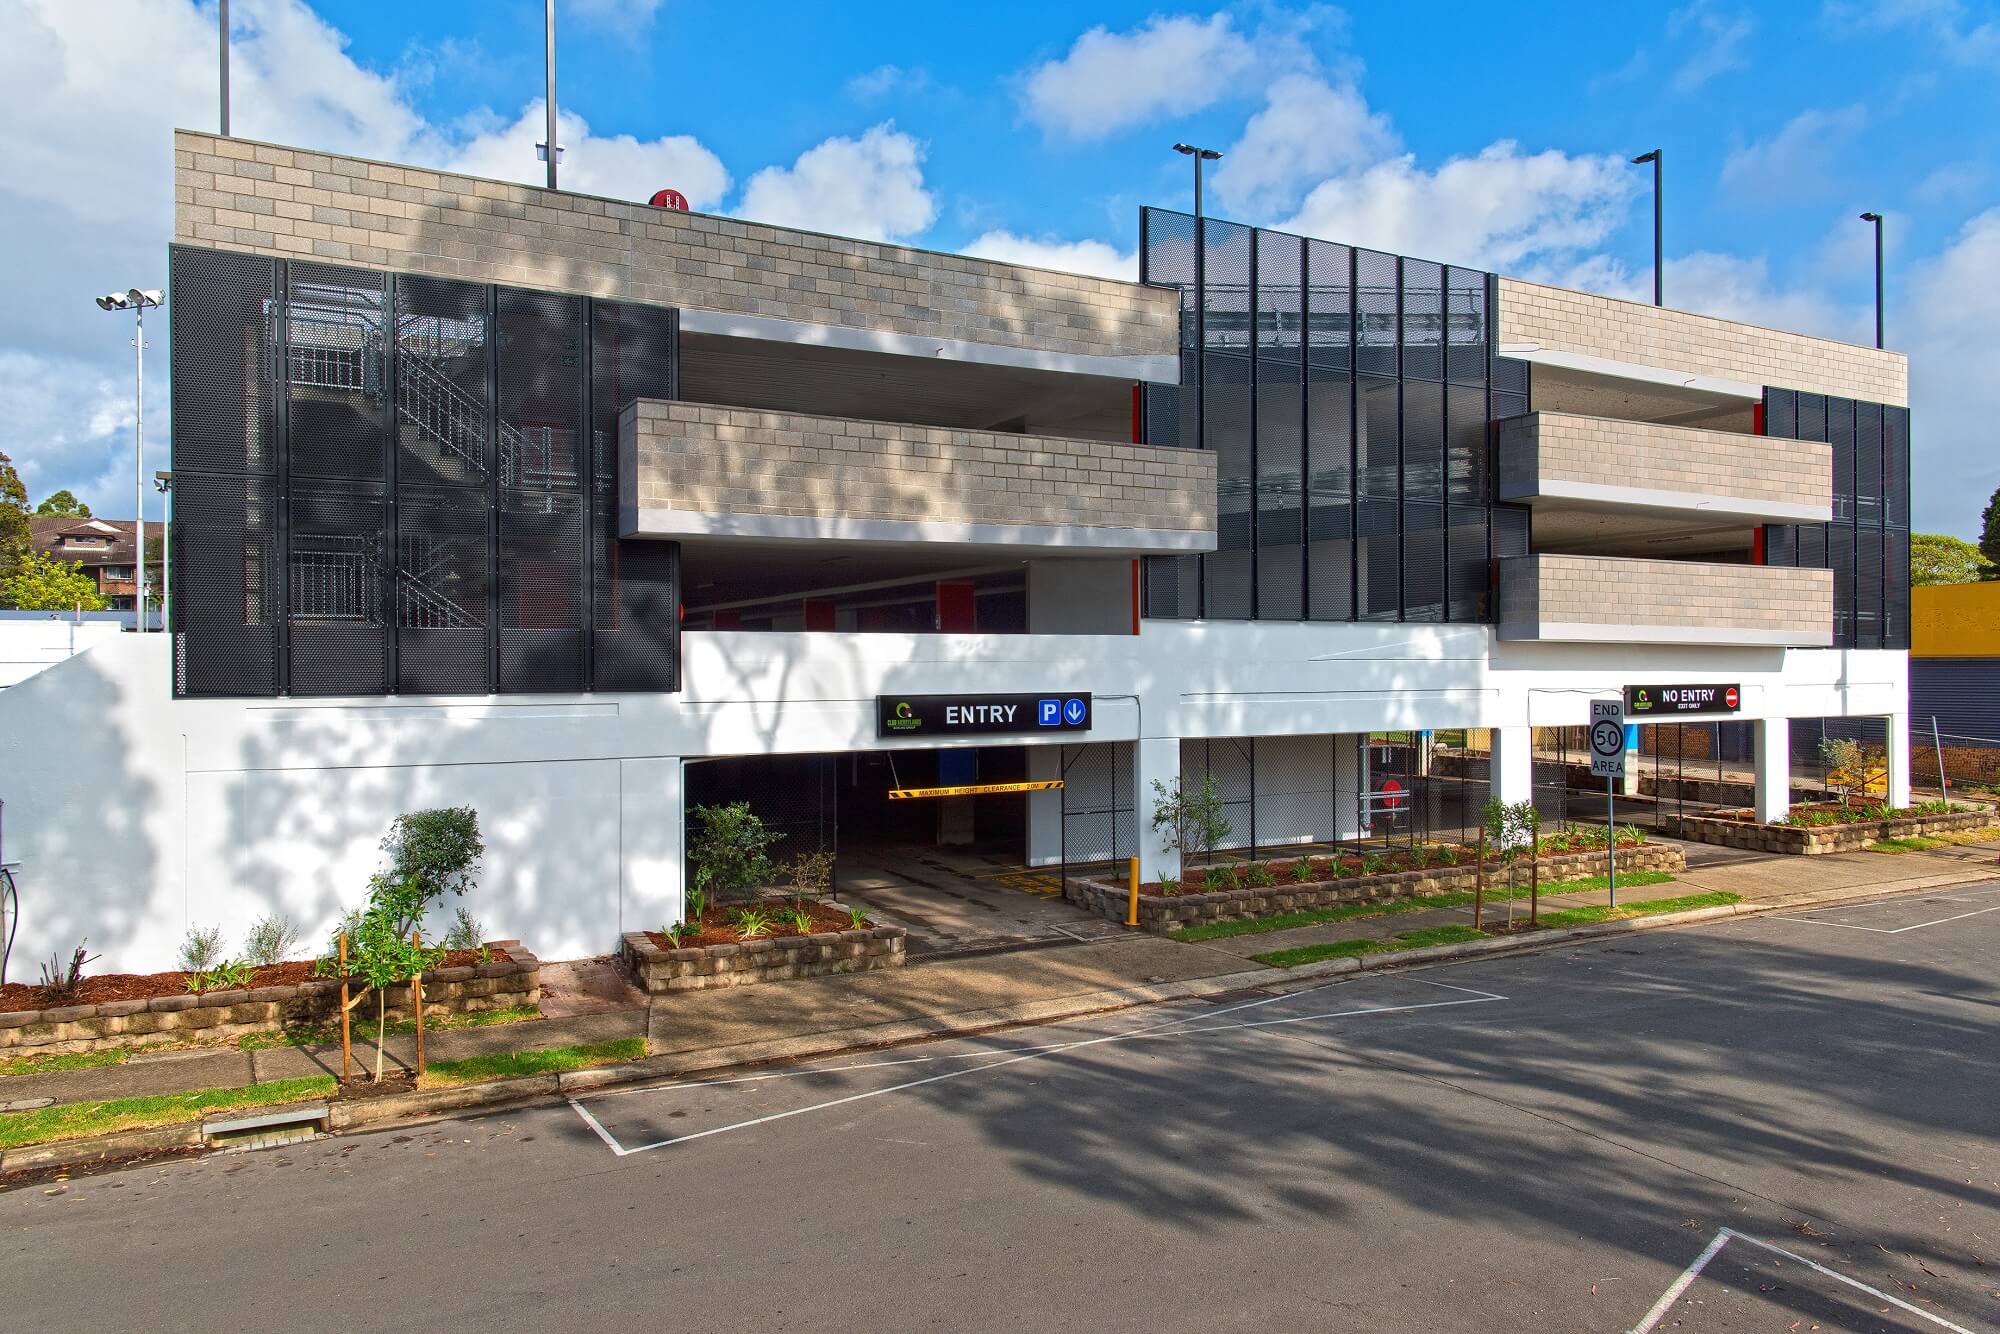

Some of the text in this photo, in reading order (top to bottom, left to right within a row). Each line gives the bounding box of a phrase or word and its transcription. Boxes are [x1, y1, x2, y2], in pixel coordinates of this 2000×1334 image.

[1662, 689, 1715, 702] NO ENTRY
[946, 704, 1018, 725] ENTRY
[1043, 703, 1057, 722] P
[1593, 704, 1619, 716] END
[1596, 731, 1618, 747] 50
[1592, 760, 1623, 773] AREA
[919, 788, 949, 797] MAXIMUM
[954, 786, 977, 794] HEIGHT
[983, 784, 1021, 793] CLEARANCE
